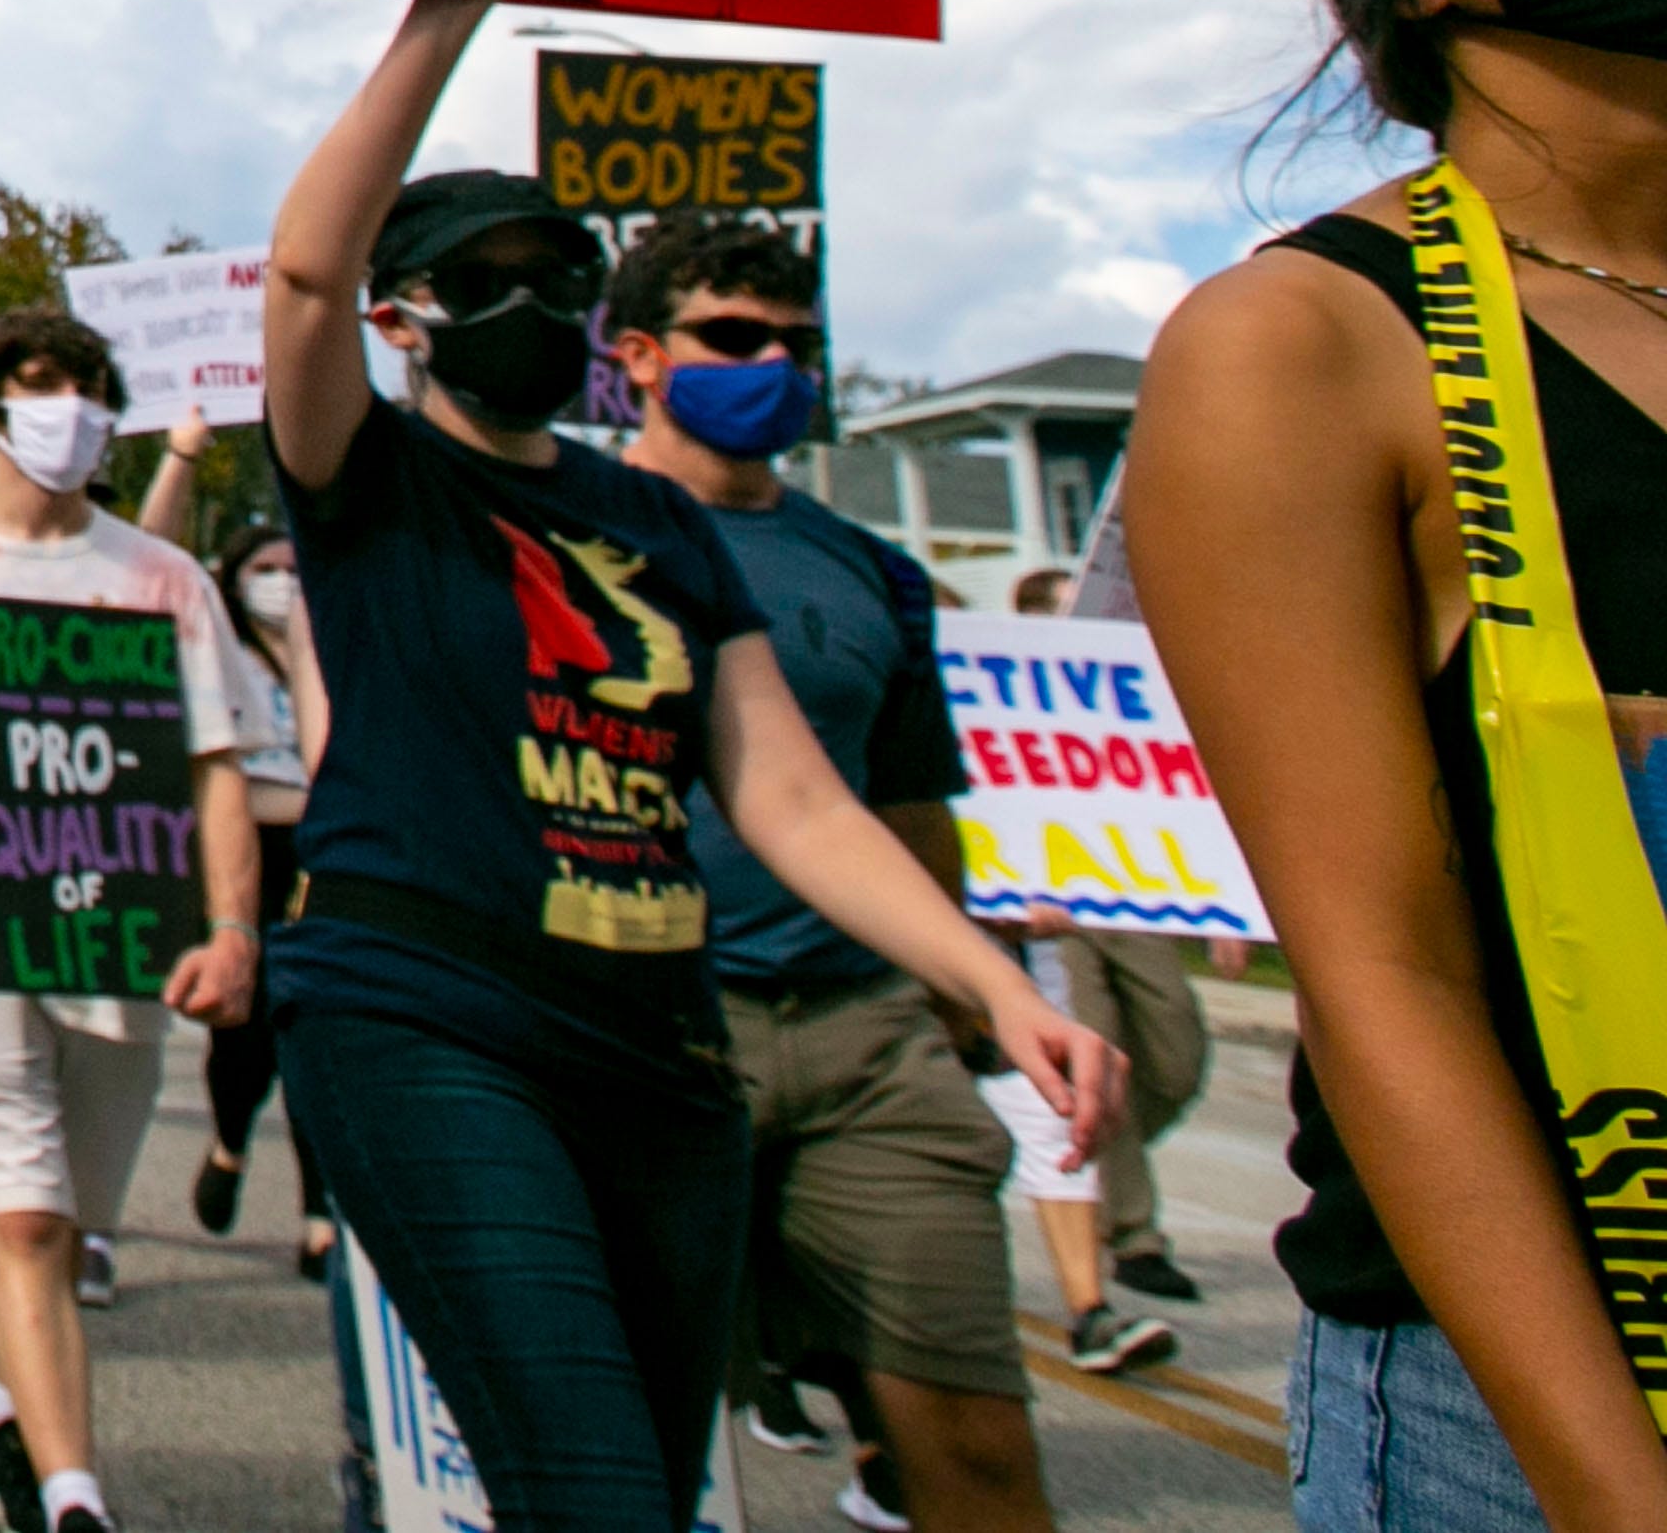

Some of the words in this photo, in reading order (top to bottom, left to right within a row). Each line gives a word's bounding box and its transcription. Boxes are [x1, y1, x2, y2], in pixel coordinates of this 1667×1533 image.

[551, 60, 817, 132] WOMEN'S
[551, 134, 807, 207] BODIES
[191, 364, 264, 387] ATTEN
[6, 719, 140, 796] PRO-
[961, 728, 1213, 799] EEDOM
[53, 871, 104, 912] OF
[1041, 818, 1220, 896] ALL
[6, 907, 167, 993] LIFE
